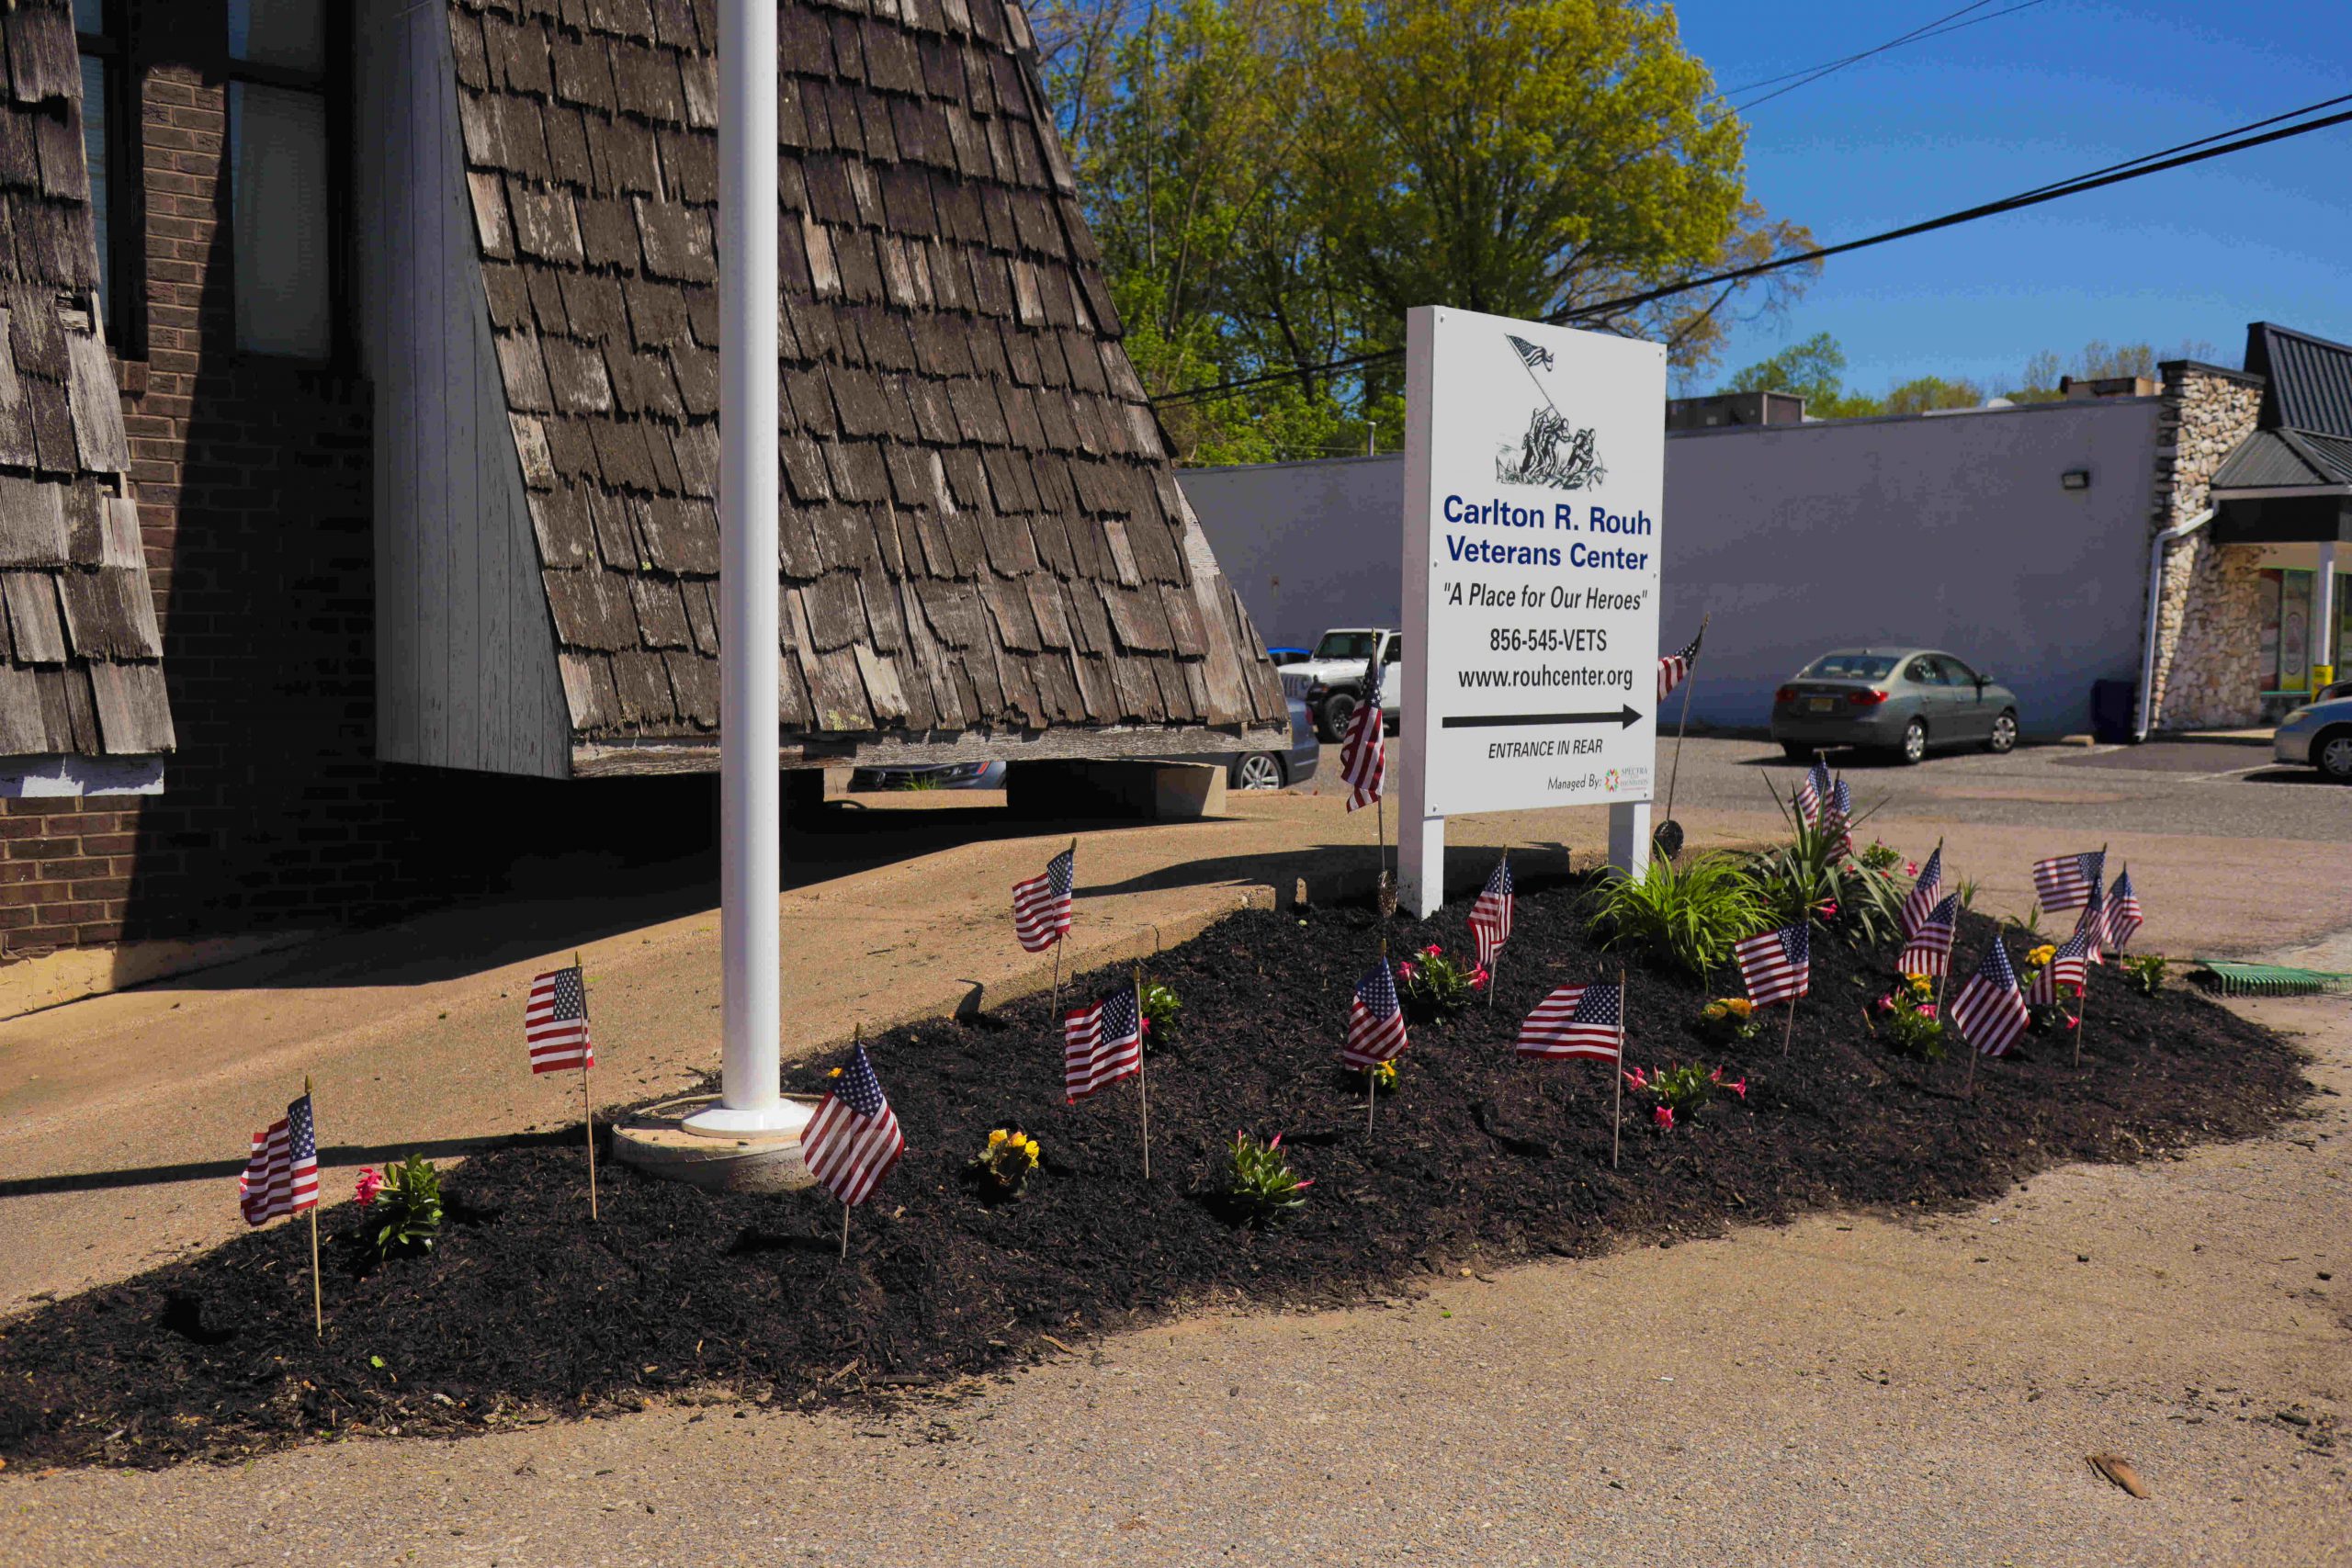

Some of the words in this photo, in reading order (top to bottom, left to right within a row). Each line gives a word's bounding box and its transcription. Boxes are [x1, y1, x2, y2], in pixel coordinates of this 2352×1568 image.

[1443, 494, 1544, 529] Carlton
[1555, 502, 1579, 531] R.
[1589, 505, 1652, 536] Rouh
[1445, 534, 1562, 567] Veterans
[1569, 542, 1648, 570] Center
[1443, 581, 1464, 606] "A
[1468, 582, 1516, 608] Place
[1521, 584, 1546, 609] for
[1550, 585, 1582, 610] Our
[1585, 586, 1648, 611] Heroes"
[1489, 628, 1608, 652] 856-545-VETS
[1458, 663, 1634, 691] www.rouhcenter.org
[1487, 740, 1555, 760] ENTRANCE
[1556, 739, 1571, 756] IN
[1572, 739, 1603, 755] REAR
[1547, 773, 1587, 792] Managed
[1589, 773, 1602, 790] By:
